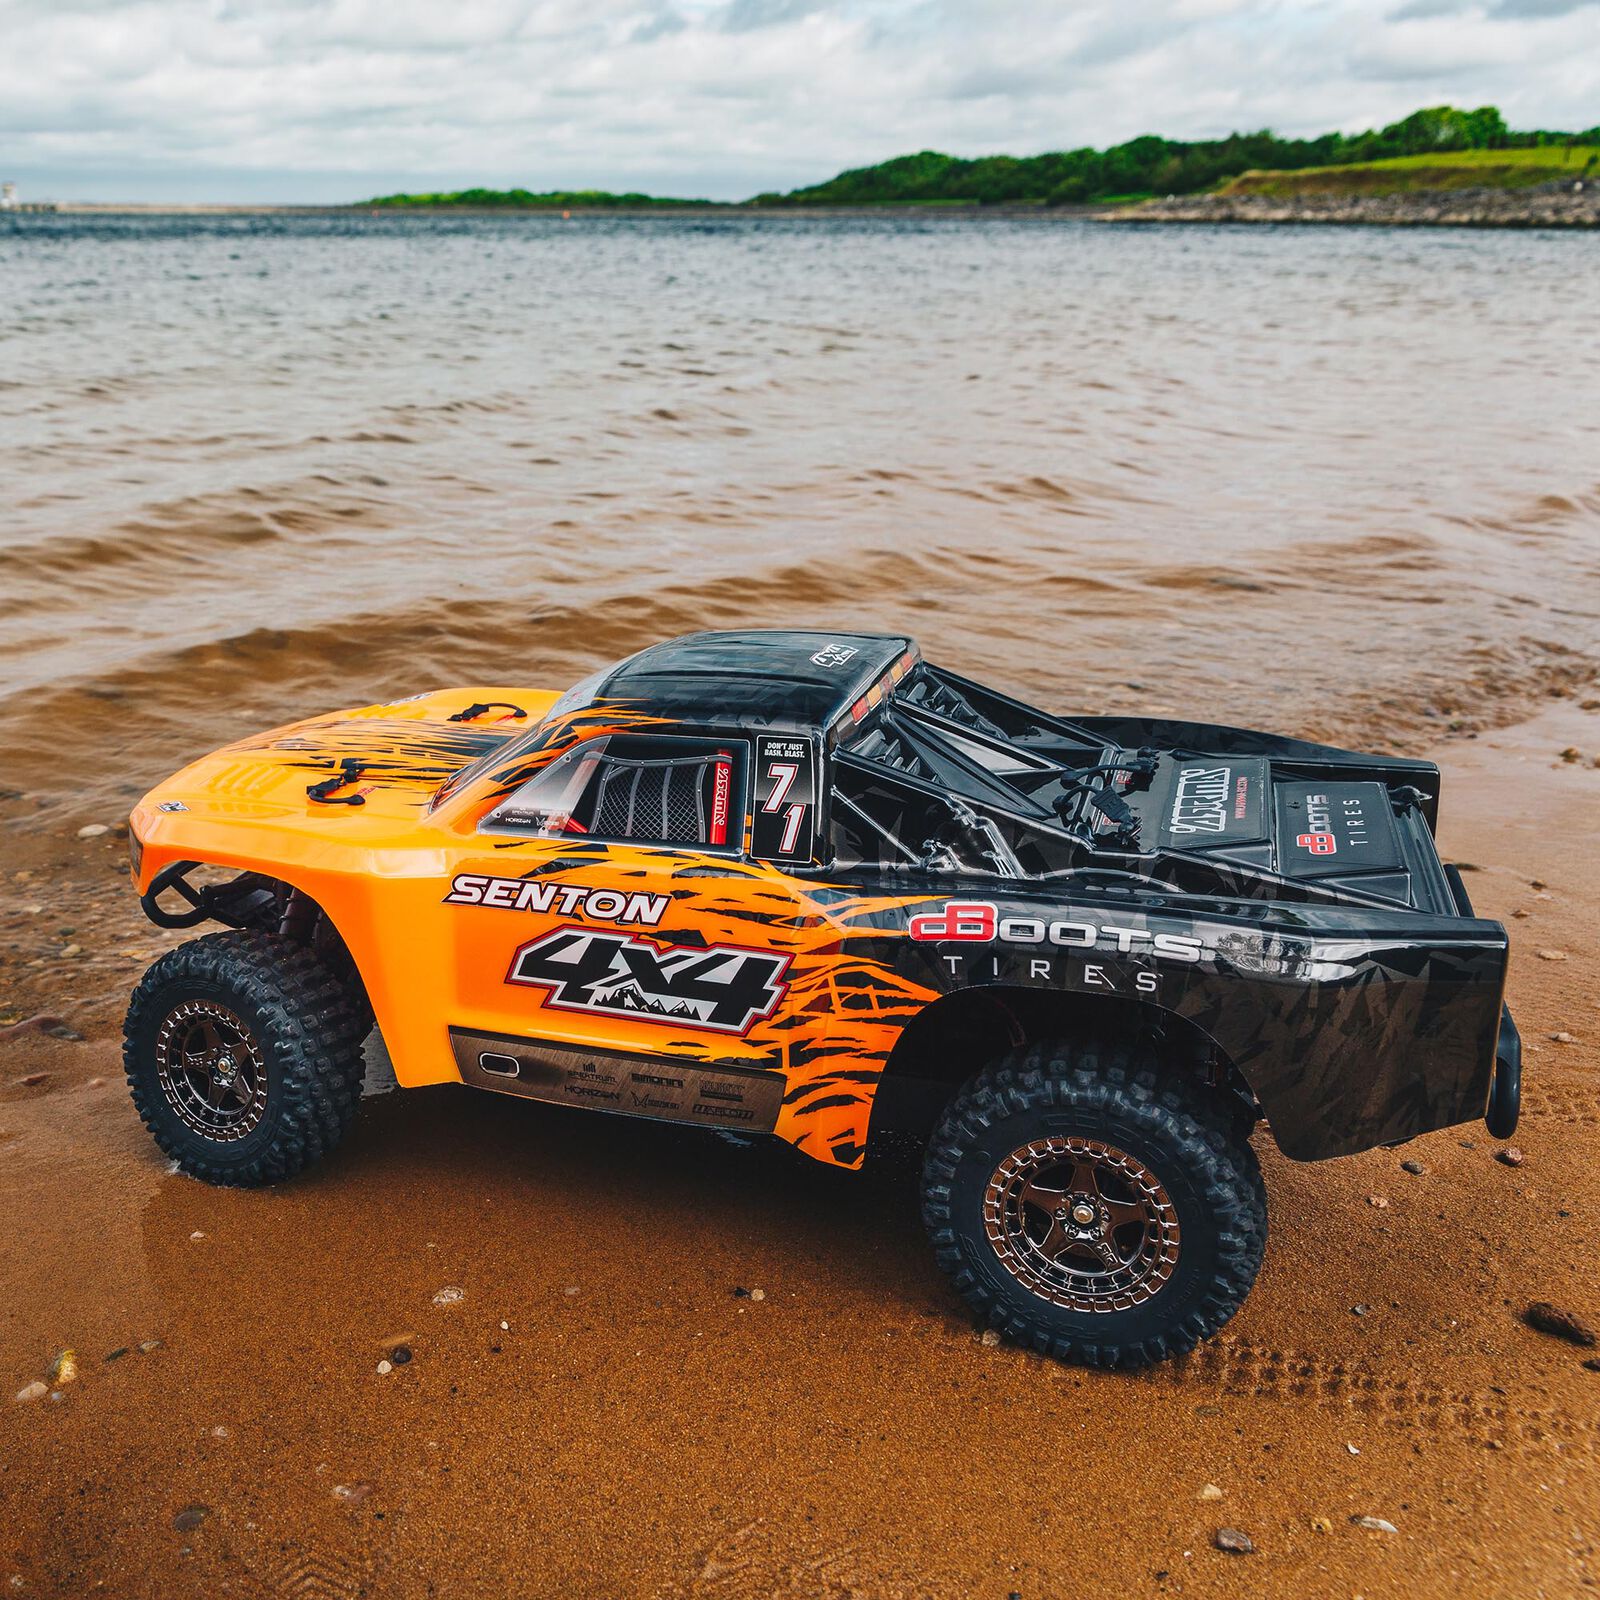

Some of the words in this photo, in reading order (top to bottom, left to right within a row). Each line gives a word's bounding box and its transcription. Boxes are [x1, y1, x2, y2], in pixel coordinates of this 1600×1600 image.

[764, 749, 783, 757] BASH.
[784, 750, 805, 758] BLAST.
[767, 742, 787, 750] DON'T
[788, 743, 804, 751] JUST
[1343, 799, 1369, 846] TIRES
[443, 874, 671, 926] SENTON
[943, 955, 1158, 992] TIRES
[564, 1085, 620, 1101] HORIZON
